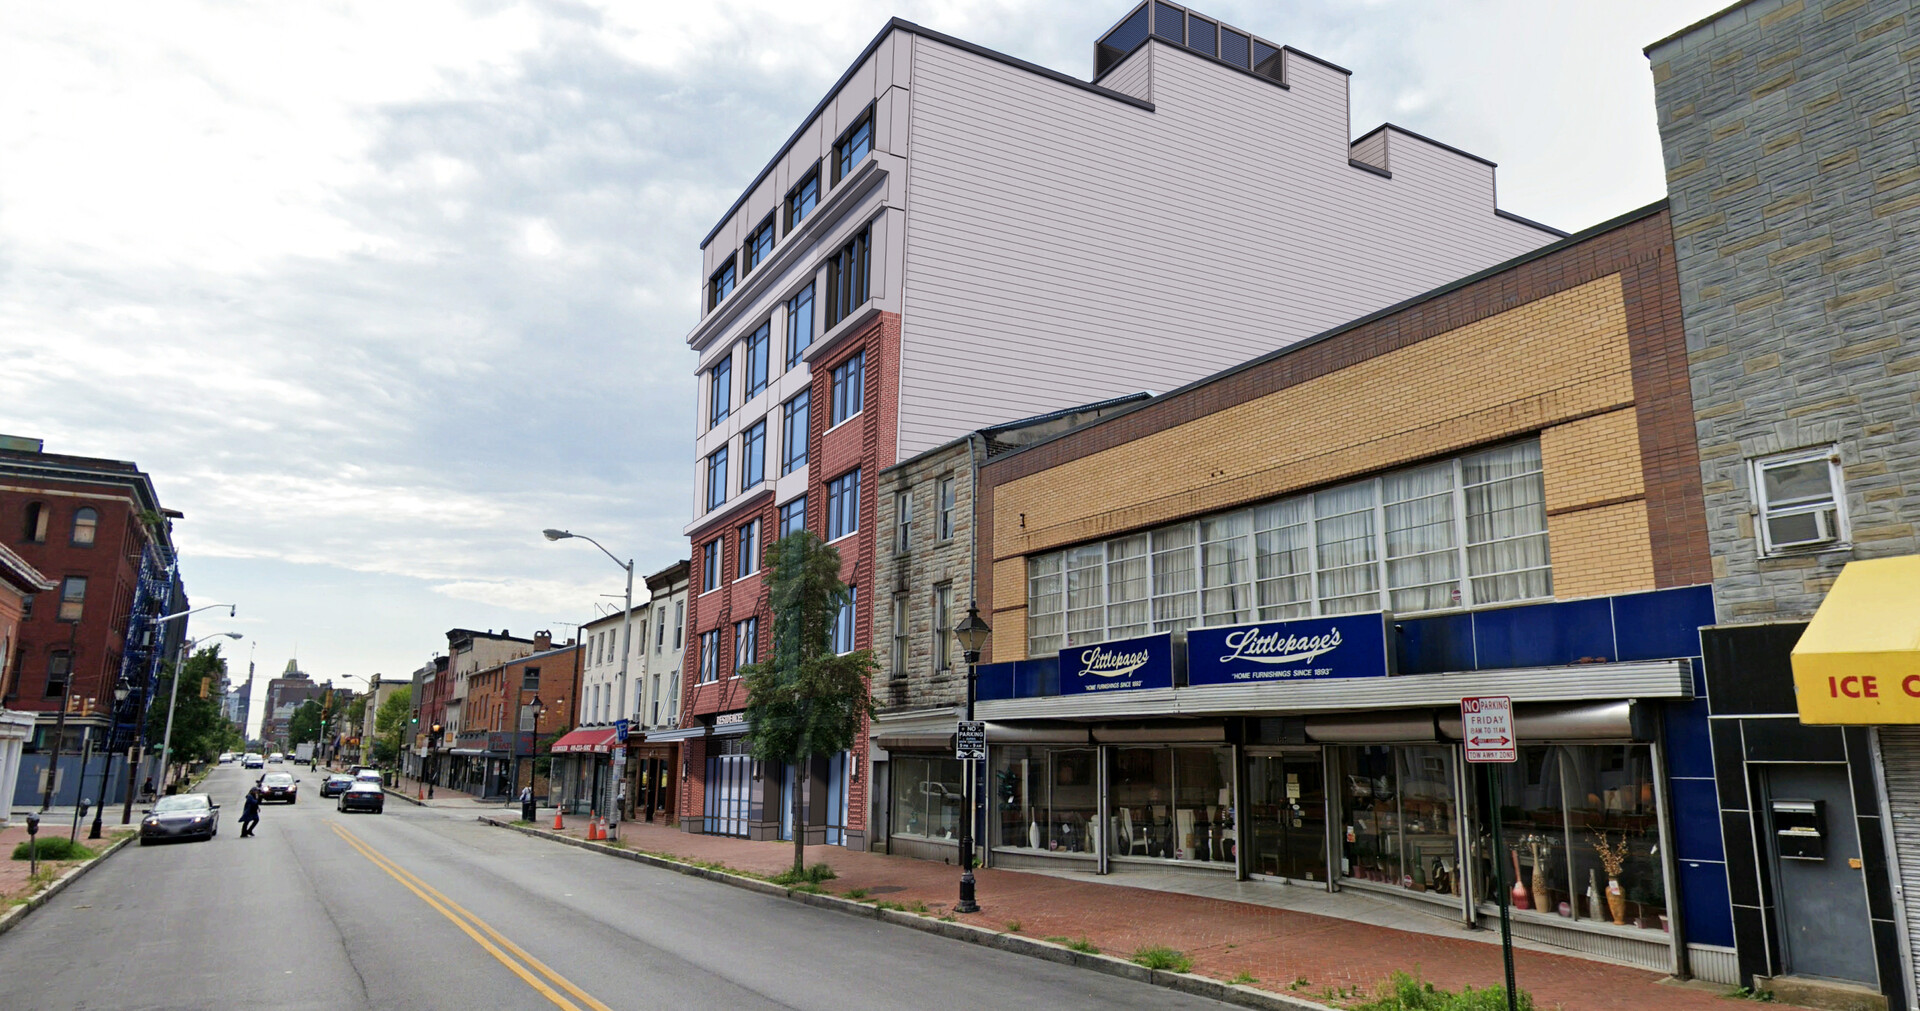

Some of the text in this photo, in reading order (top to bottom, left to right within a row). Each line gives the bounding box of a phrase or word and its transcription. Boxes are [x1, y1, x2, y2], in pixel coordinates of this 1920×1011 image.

[1220, 627, 1343, 664] Littlepage's
[1252, 670, 1292, 679] FURNISHINGS
[1293, 668, 1312, 677] SINCE
[1828, 675, 1879, 698] ICE
[1464, 700, 1508, 712] NO PARKING
[1471, 715, 1504, 724] FRIDAY
